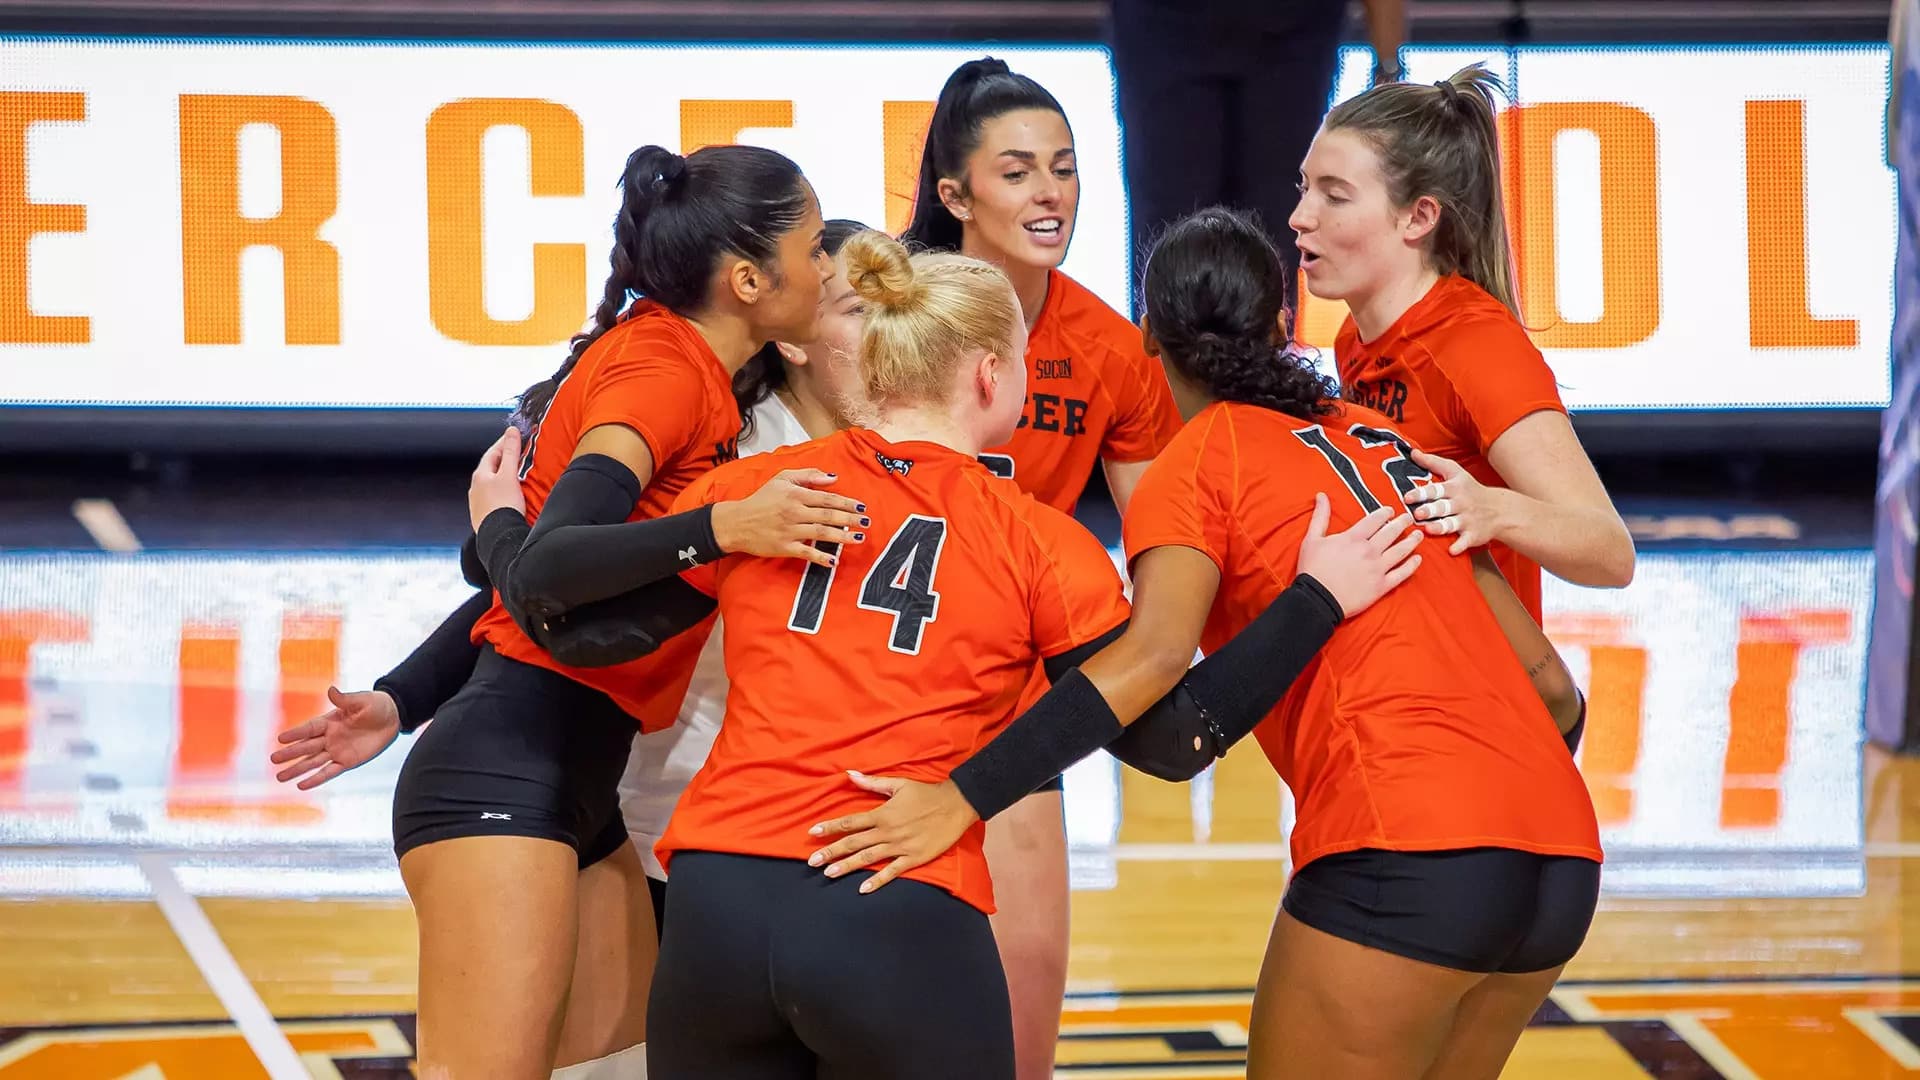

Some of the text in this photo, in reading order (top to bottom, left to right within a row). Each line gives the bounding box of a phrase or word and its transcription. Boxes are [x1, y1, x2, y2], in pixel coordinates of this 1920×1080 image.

[1294, 99, 1860, 349] OL
[1035, 358, 1072, 380] SOCON
[1290, 423, 1433, 525] 12
[787, 513, 947, 656] 14
